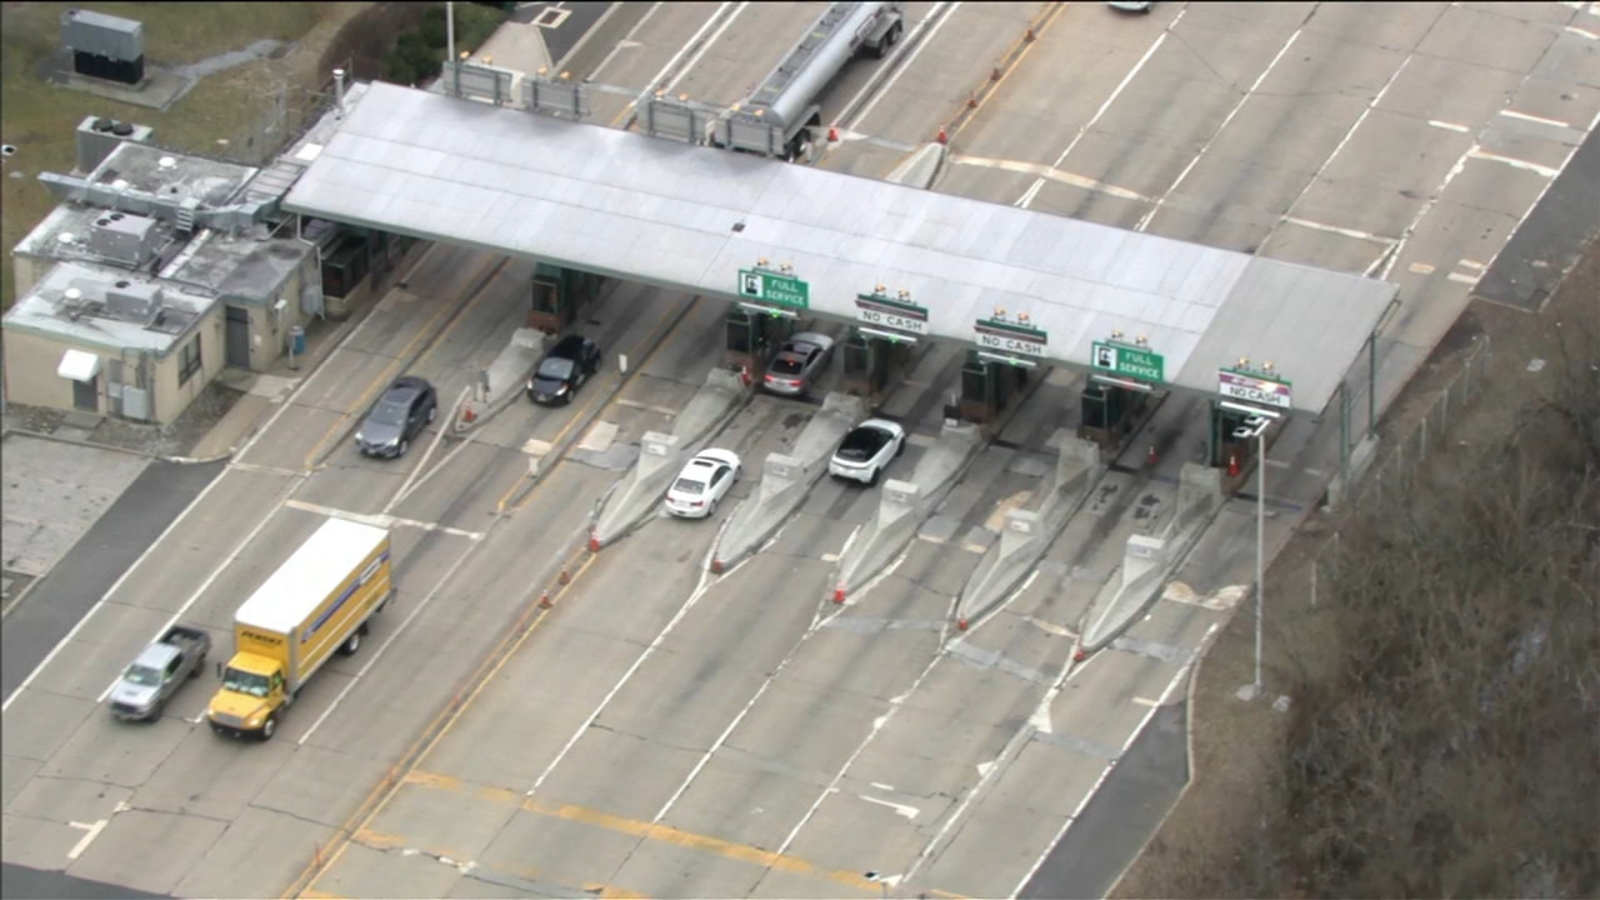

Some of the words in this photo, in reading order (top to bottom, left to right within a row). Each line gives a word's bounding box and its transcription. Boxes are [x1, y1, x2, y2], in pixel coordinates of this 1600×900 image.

[771, 279, 798, 292] FULL
[863, 310, 881, 322] NO
[887, 315, 922, 330] CASH
[982, 335, 1000, 347] NO
[1006, 340, 1042, 354] CASH
[1126, 352, 1153, 366] FULL
[1119, 362, 1160, 378] SERVICE
[1229, 386, 1246, 397] NO
[1248, 390, 1281, 403] CASH
